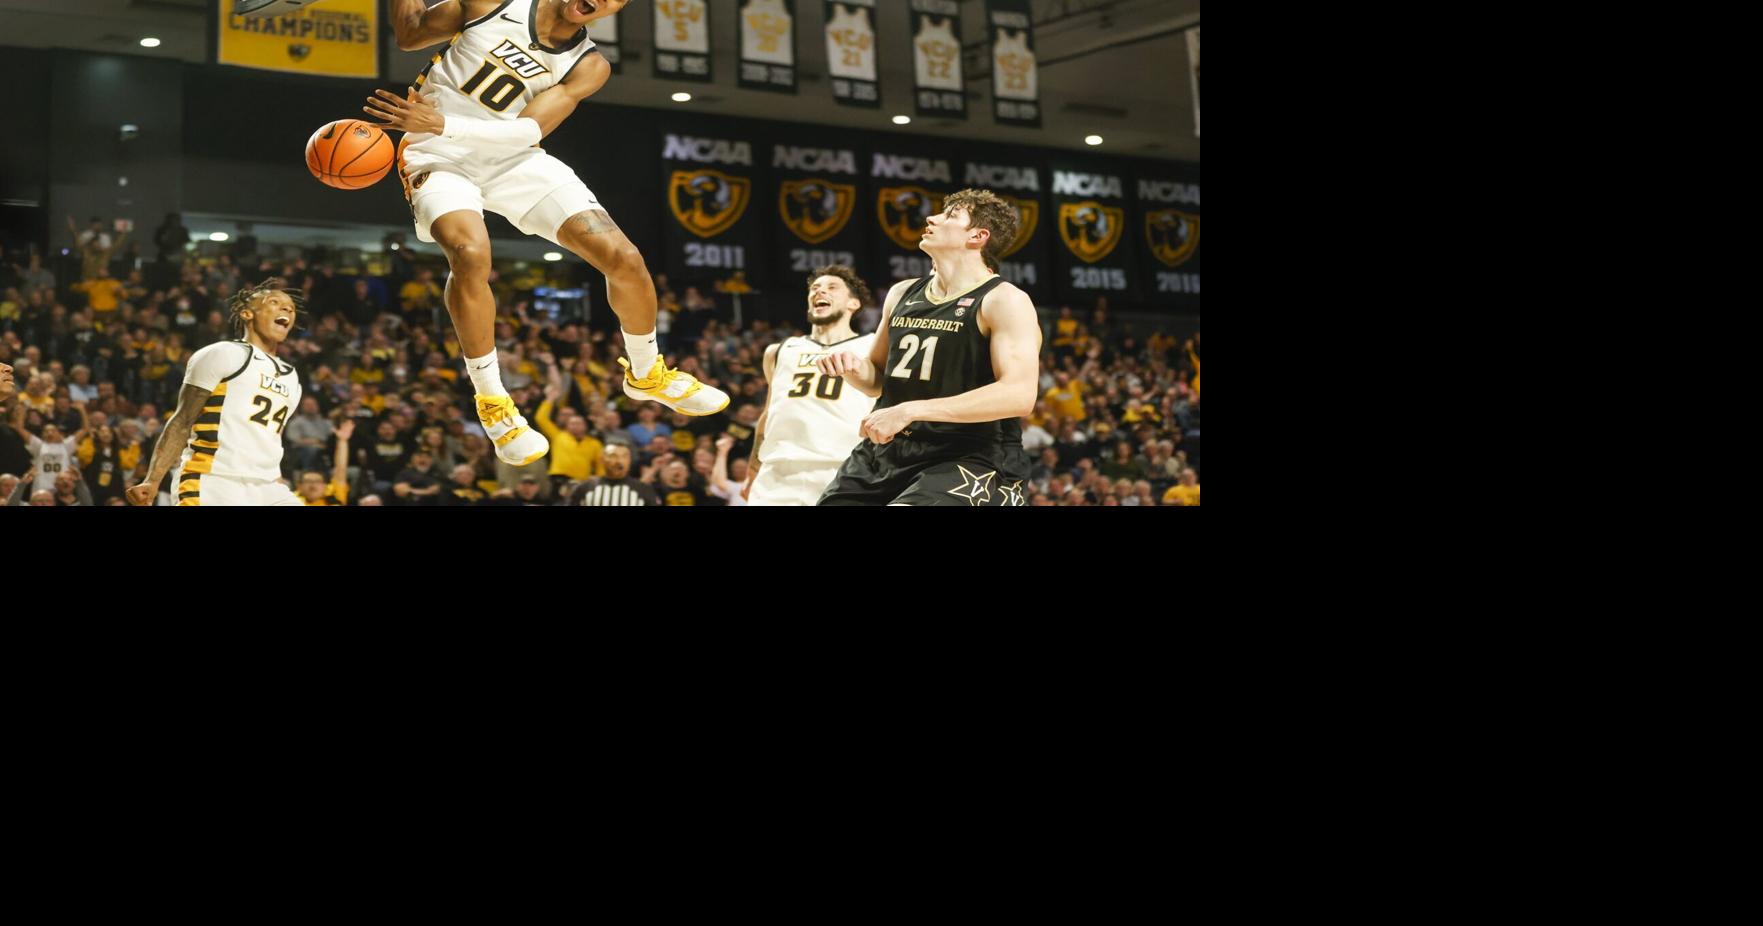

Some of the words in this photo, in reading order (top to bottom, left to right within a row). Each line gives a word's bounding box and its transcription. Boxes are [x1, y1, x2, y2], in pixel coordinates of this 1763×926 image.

[229, 12, 369, 43] CHAMPIONS
[489, 39, 550, 79] VCU
[460, 59, 526, 112] 10
[662, 134, 752, 166] NCAA
[773, 145, 857, 174] NCAA
[872, 153, 951, 184] NCAA
[965, 163, 1040, 192] NCAA
[1052, 170, 1123, 198] NCAA
[684, 243, 744, 269] 2011
[889, 255, 930, 278] 201
[1070, 266, 1126, 290] 2015
[891, 316, 964, 333] VANDERBILT
[891, 333, 939, 381] 21
[259, 373, 289, 398] VCU
[788, 372, 844, 401] 30
[249, 394, 289, 434] 24
[970, 480, 985, 498] V
